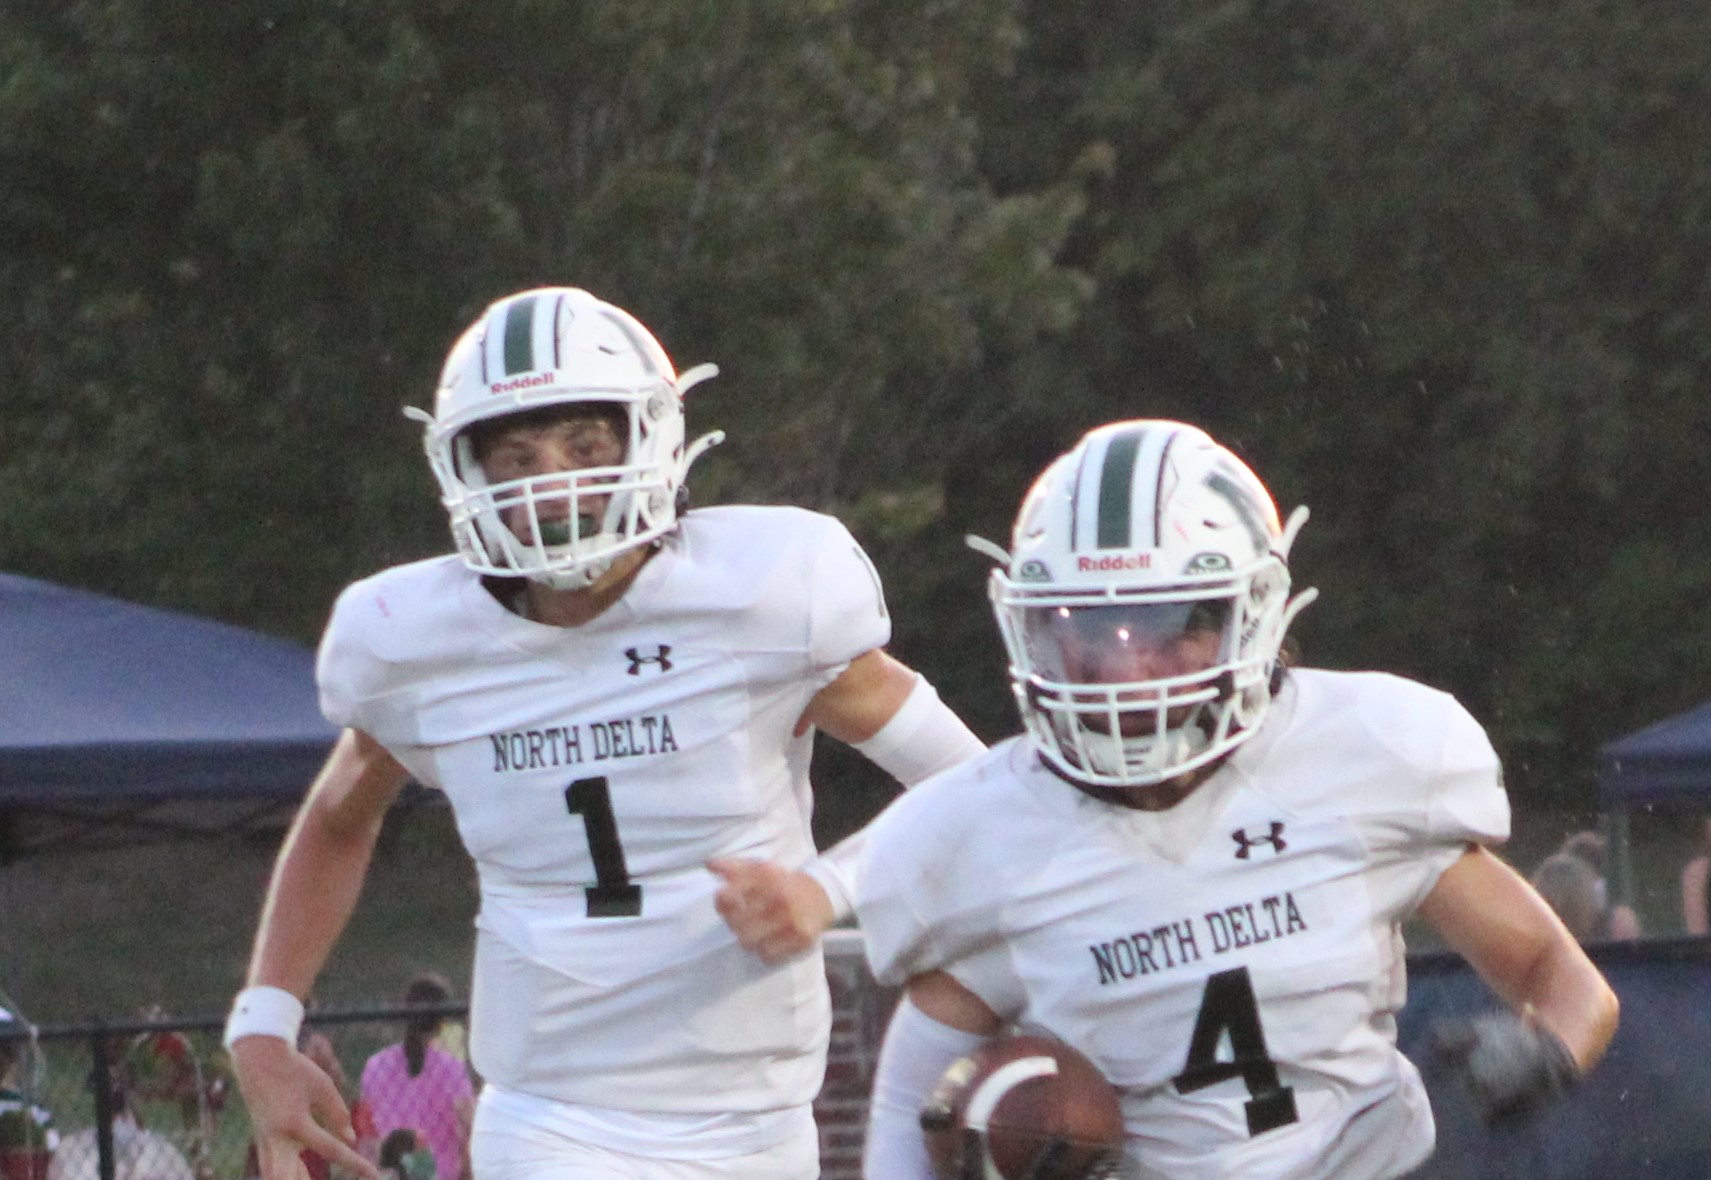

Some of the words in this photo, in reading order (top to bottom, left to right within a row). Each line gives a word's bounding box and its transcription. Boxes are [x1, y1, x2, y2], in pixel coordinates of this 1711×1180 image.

[491, 372, 554, 394] Riddell
[1078, 553, 1152, 571] Riddell
[490, 727, 583, 772] NORTH
[589, 715, 679, 761] DELTA
[564, 776, 642, 917] 1
[1089, 919, 1203, 985] NORTH
[1204, 892, 1307, 953] DELTA
[1172, 965, 1299, 1137] 4
